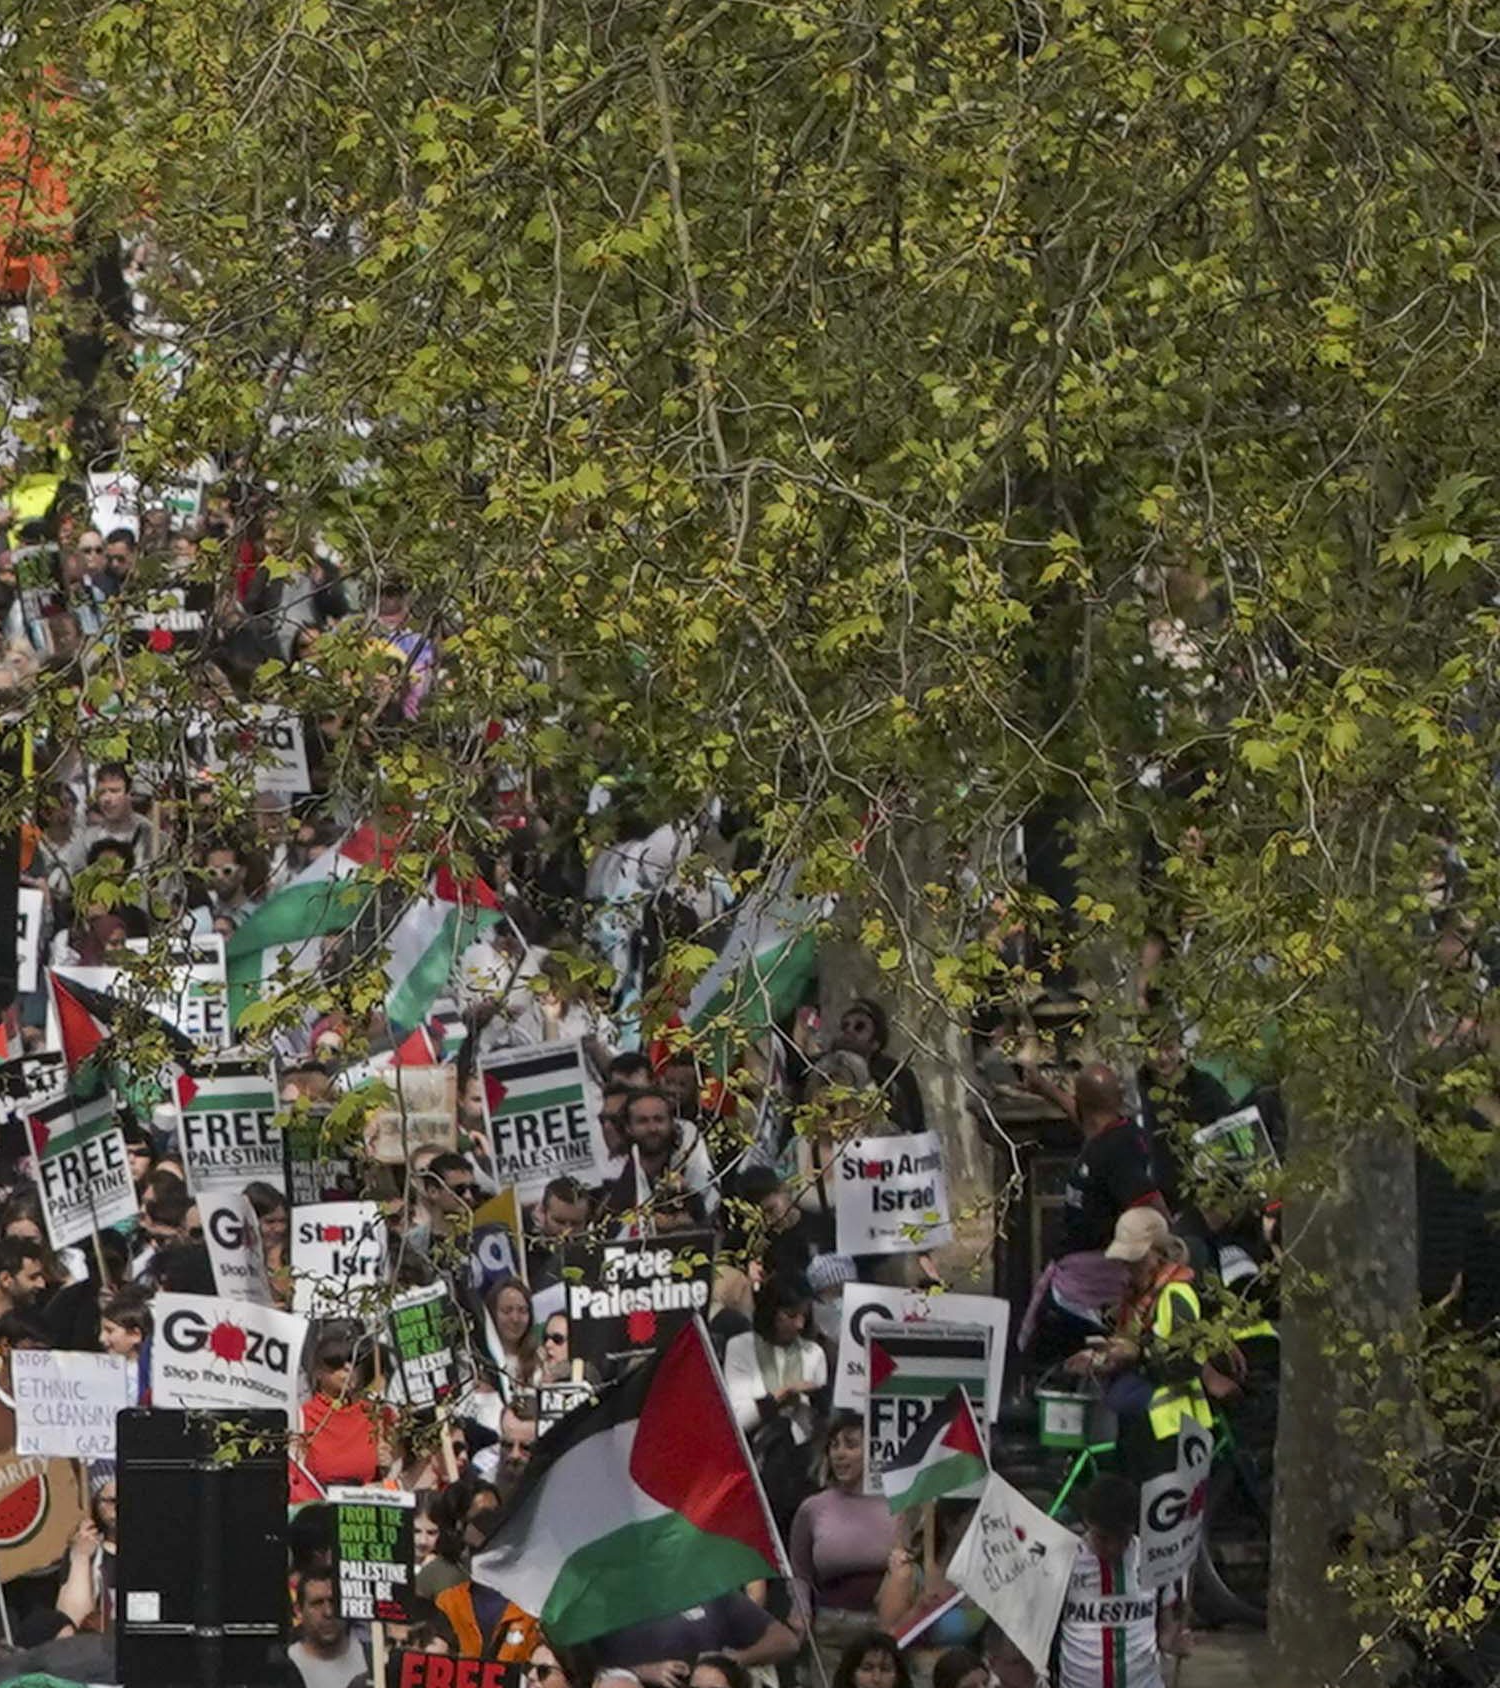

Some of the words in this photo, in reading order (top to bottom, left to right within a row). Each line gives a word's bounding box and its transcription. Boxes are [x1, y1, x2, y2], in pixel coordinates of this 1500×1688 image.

[182, 1106, 279, 1152] FREE
[490, 1103, 593, 1153] FREE
[39, 1131, 125, 1194] FREE
[186, 1142, 285, 1168] PALESTINE
[494, 1137, 594, 1171] PALESTINE
[47, 1168, 130, 1219] PALESTINE
[605, 1246, 673, 1284] Free
[570, 1276, 709, 1318] Palestine
[161, 1310, 290, 1376] Gza
[339, 1561, 407, 1583] PALESTINE
[1063, 1600, 1160, 1625] PALESTINE
